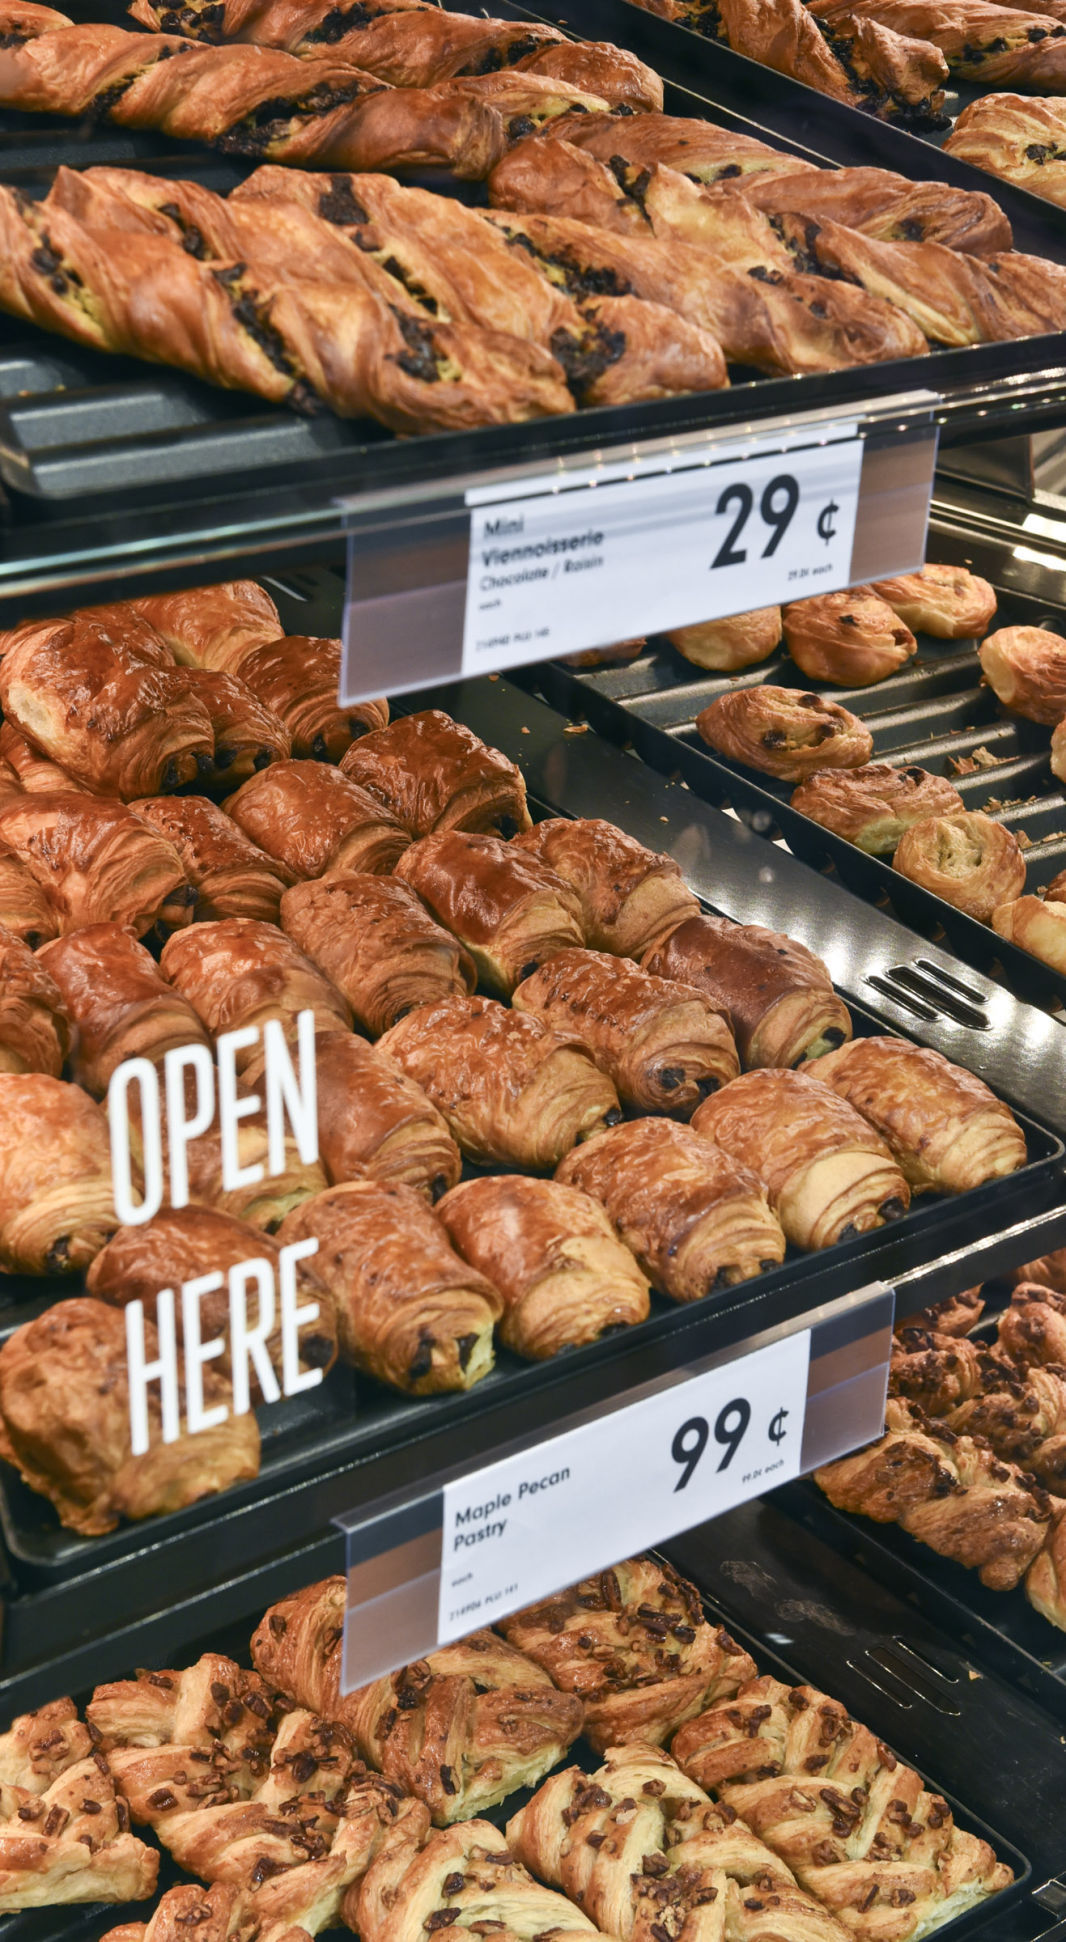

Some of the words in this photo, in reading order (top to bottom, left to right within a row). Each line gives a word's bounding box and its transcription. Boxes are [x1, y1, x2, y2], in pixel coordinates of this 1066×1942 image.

[483, 514, 525, 539] Mini
[709, 474, 800, 570] 29
[816, 499, 840, 546] ¢
[482, 530, 604, 567] Viennoisserie
[479, 568, 549, 591] Chocolate
[564, 556, 604, 573] Raisin
[108, 1009, 318, 1226] OPEN
[125, 1237, 323, 1456] HERE
[672, 1397, 751, 1494] 99
[768, 1406, 790, 1447] ¢
[764, 1459, 785, 1474] each
[455, 1493, 512, 1528] Maple
[518, 1466, 571, 1500] Pecan
[454, 1518, 508, 1552] Pastry
